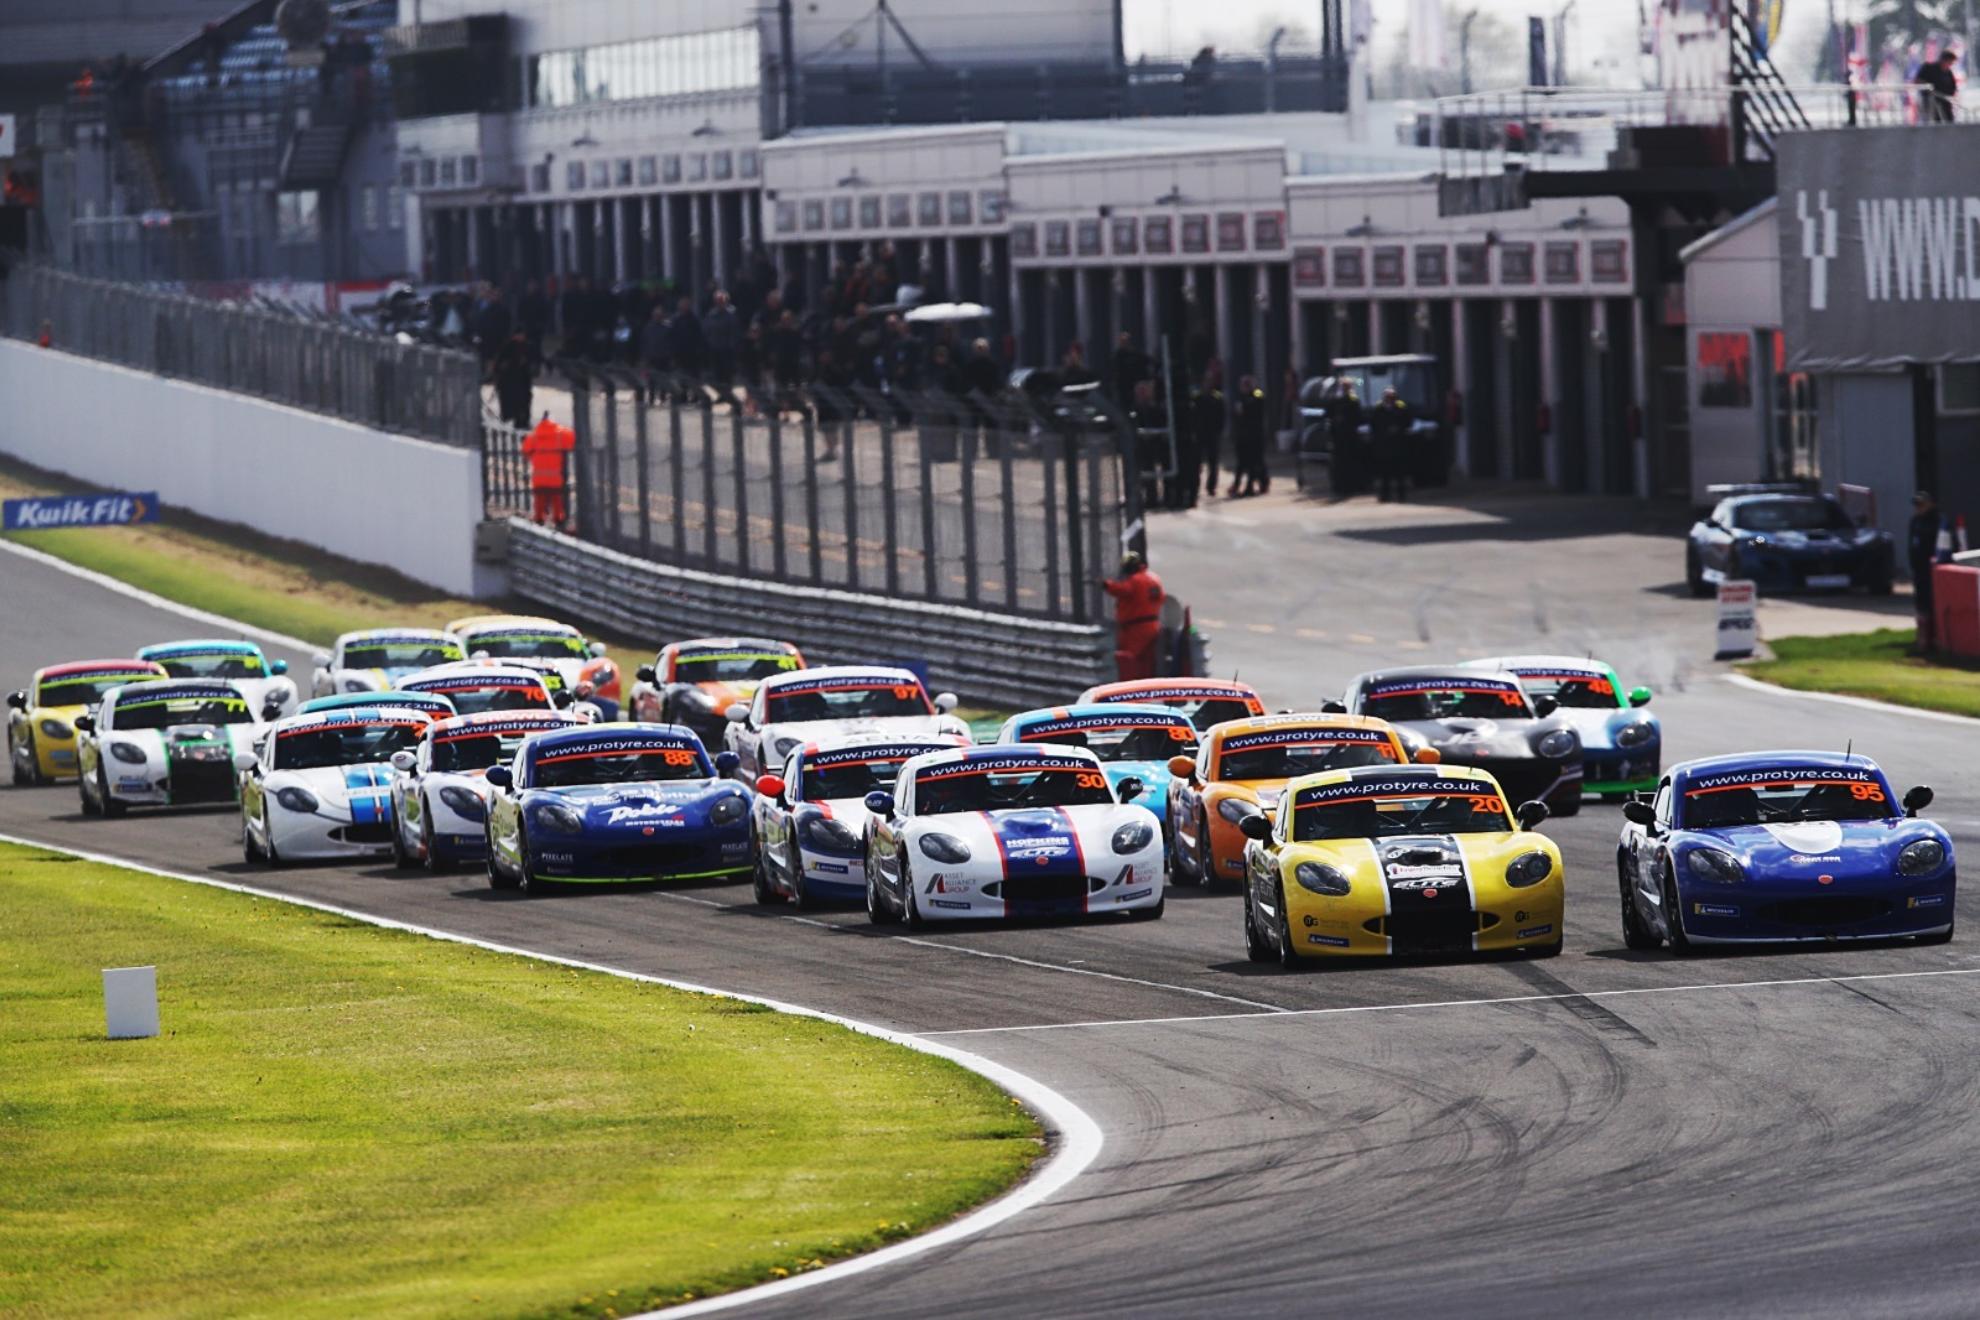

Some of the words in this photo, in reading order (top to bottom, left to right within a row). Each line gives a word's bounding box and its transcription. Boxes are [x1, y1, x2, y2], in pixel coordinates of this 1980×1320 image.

[411, 677, 529, 691] www.protyre.co.uk
[779, 677, 905, 692] www.protyre.co.uk
[1375, 681, 1508, 695] www.protyre.co.uk
[1108, 688, 1244, 702] www.protyre.co.uk
[447, 719, 577, 737] www.protyre.co.u
[1032, 714, 1176, 734] www.protyre.co.uk
[1229, 730, 1379, 749] www.protyre.co.uk
[544, 740, 685, 758] www.protyre.co.uk
[816, 746, 939, 764] www.protyre.co
[664, 751, 693, 766] 88
[929, 757, 1085, 777] www.protyre.co.uk
[1076, 773, 1106, 789] 30
[1699, 769, 1870, 788] www.protyre.co.uk
[1310, 780, 1481, 800] www.protyre.co.uk
[1851, 783, 1886, 802] 95
[1469, 797, 1504, 813] 20
